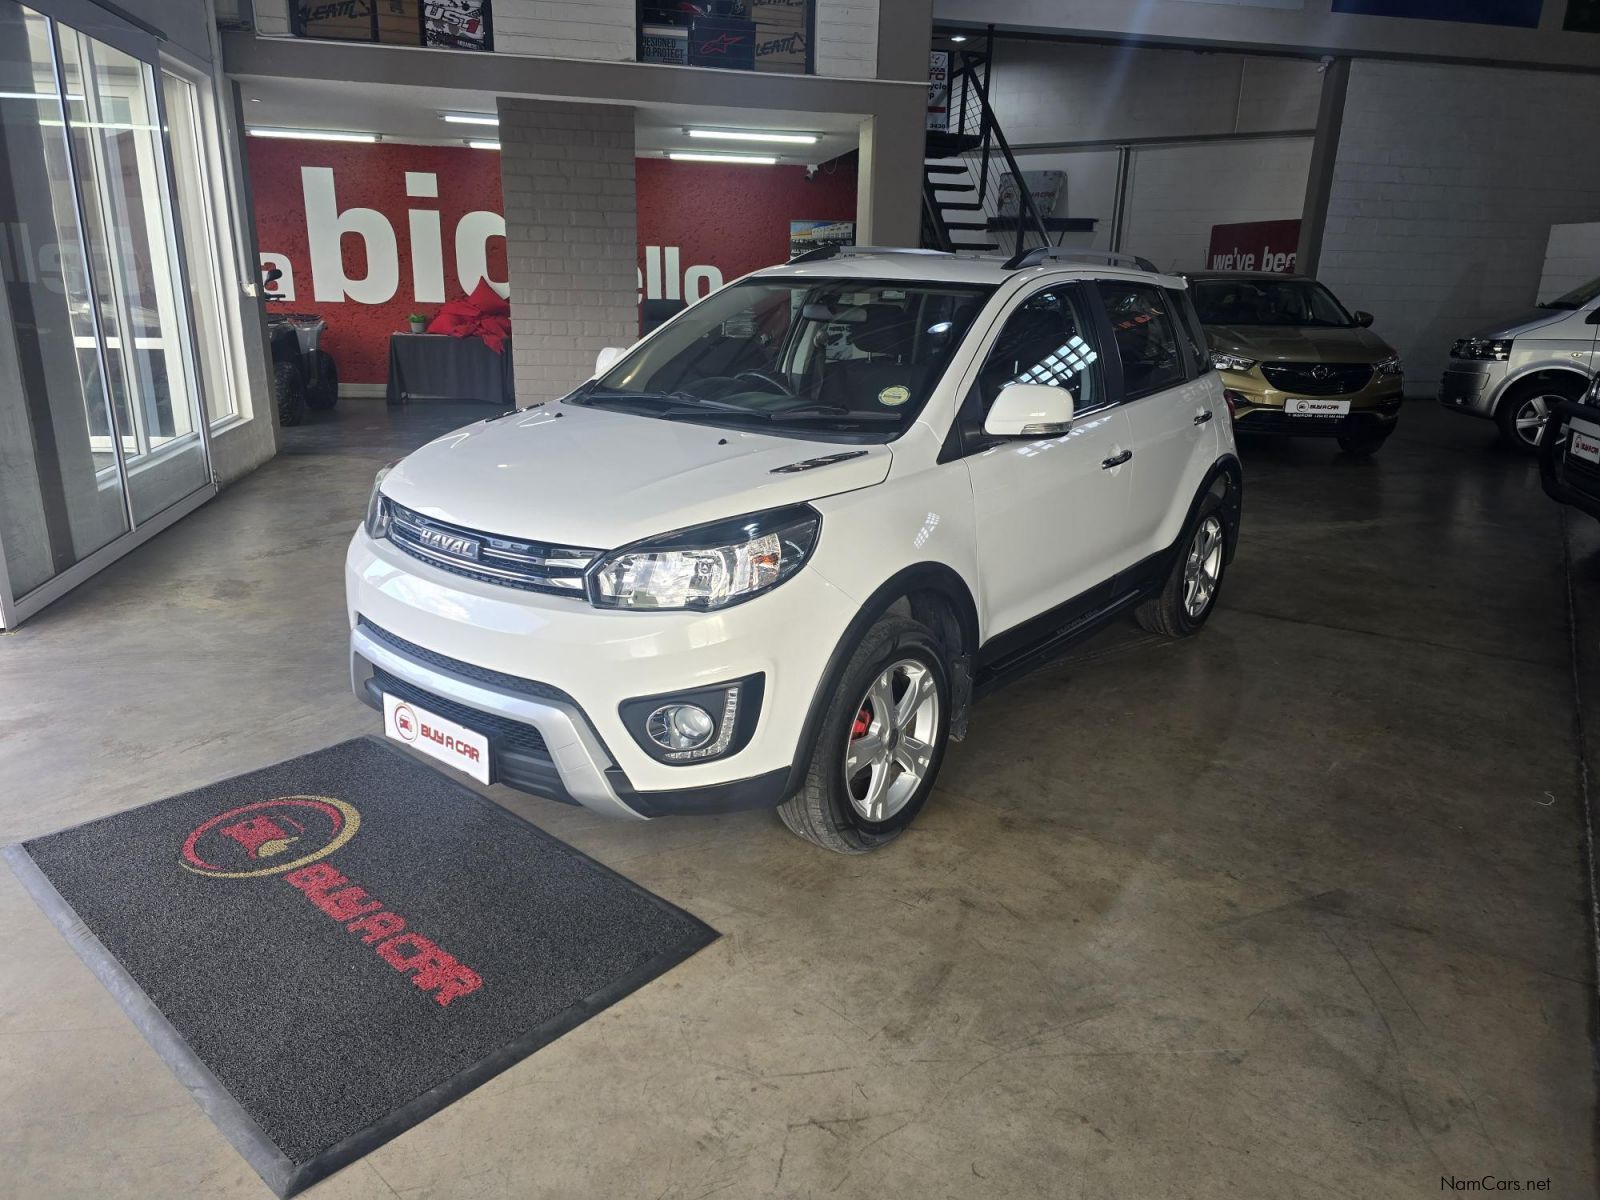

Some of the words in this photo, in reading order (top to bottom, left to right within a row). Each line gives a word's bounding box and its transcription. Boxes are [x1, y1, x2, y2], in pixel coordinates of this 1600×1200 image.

[637, 246, 724, 306] llo
[1213, 247, 1255, 271] we've
[421, 529, 473, 557] HAVAL
[420, 723, 445, 746] BUY
[445, 735, 454, 750] A
[455, 740, 480, 763] CAR
[283, 862, 382, 922] BUY
[346, 911, 406, 944] A
[375, 931, 484, 1008] CAR
